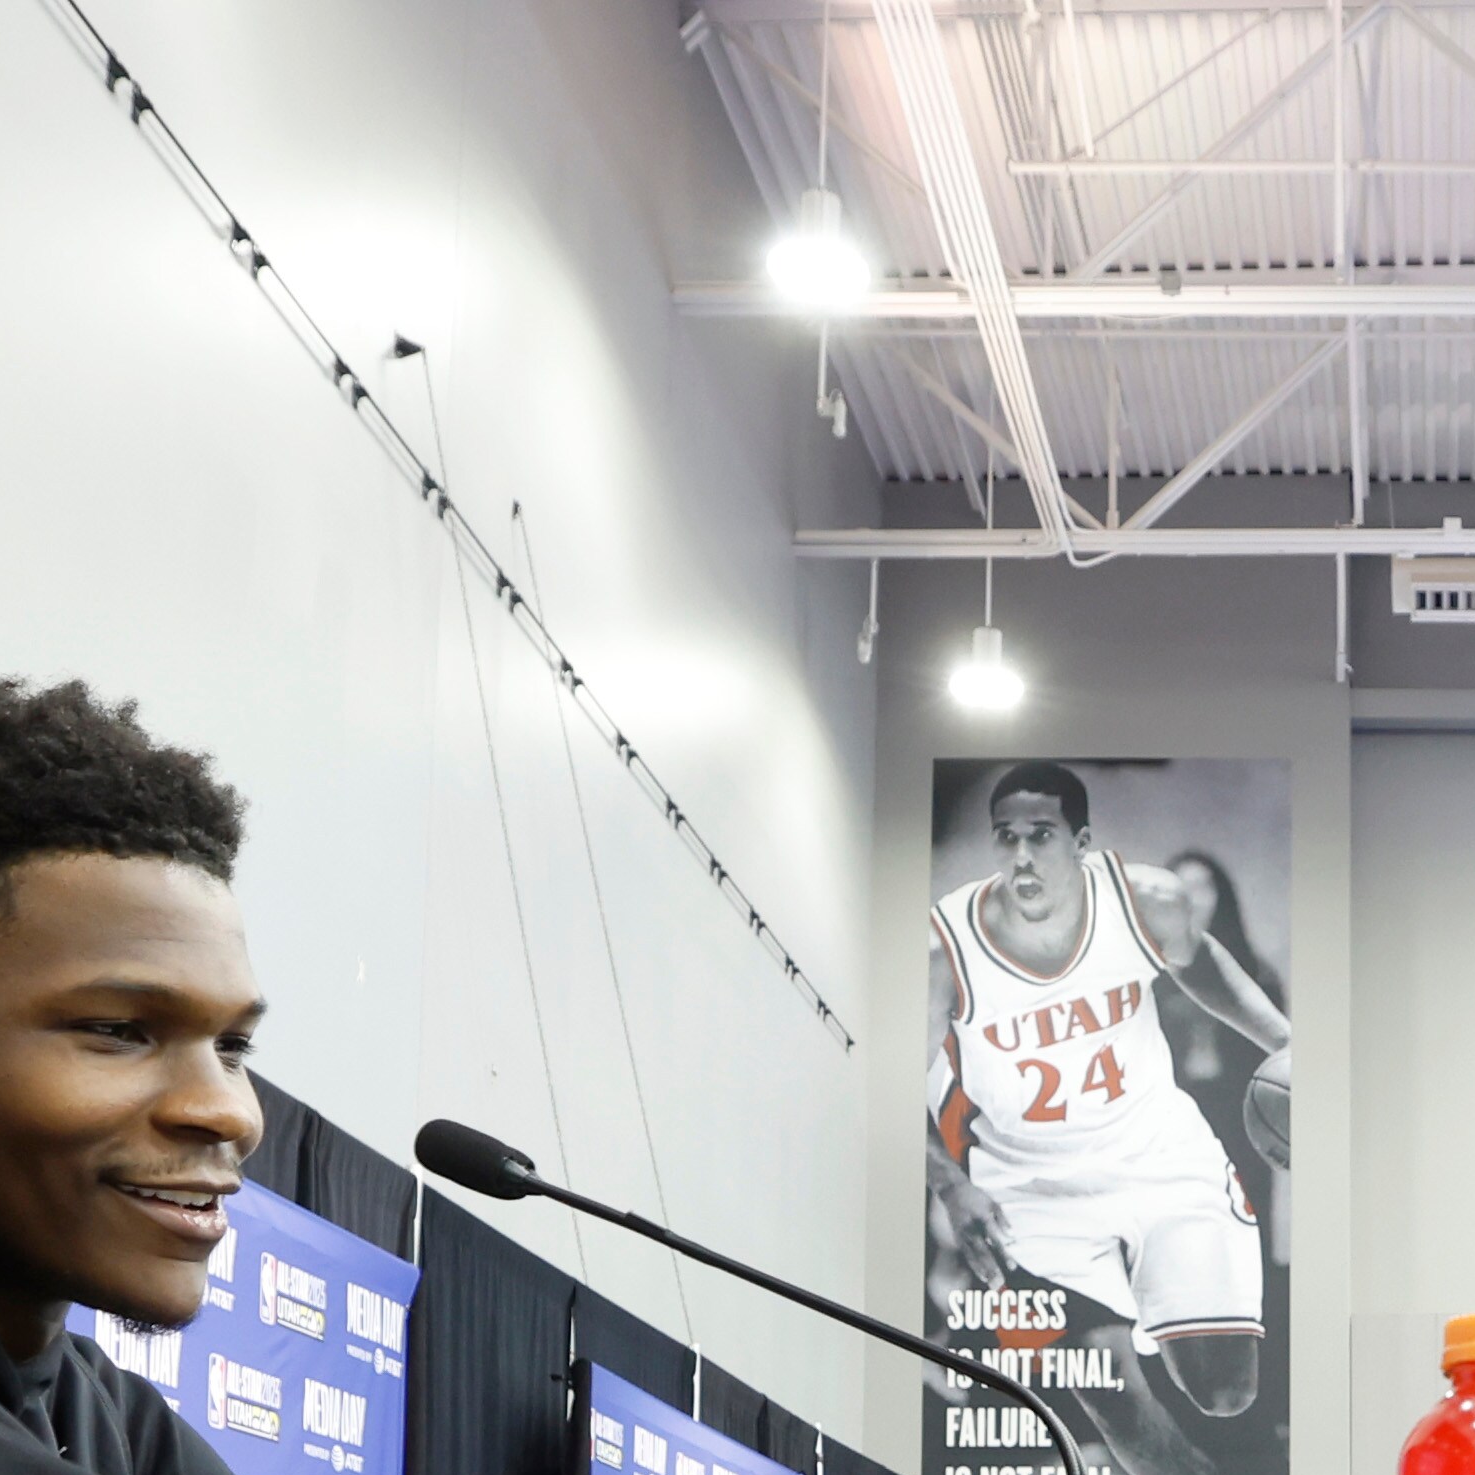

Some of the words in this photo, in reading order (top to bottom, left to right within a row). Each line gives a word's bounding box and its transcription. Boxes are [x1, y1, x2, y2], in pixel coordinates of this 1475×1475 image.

[982, 980, 1141, 1052] UTAH
[1015, 1043, 1126, 1122] 24
[346, 1281, 381, 1345] MEDIA
[382, 1297, 405, 1354] DAY
[947, 1289, 1067, 1331] SUCCESS
[1041, 1348, 1124, 1391] FINAL,
[303, 1377, 341, 1441] MEDIA
[341, 1391, 366, 1447] DAY
